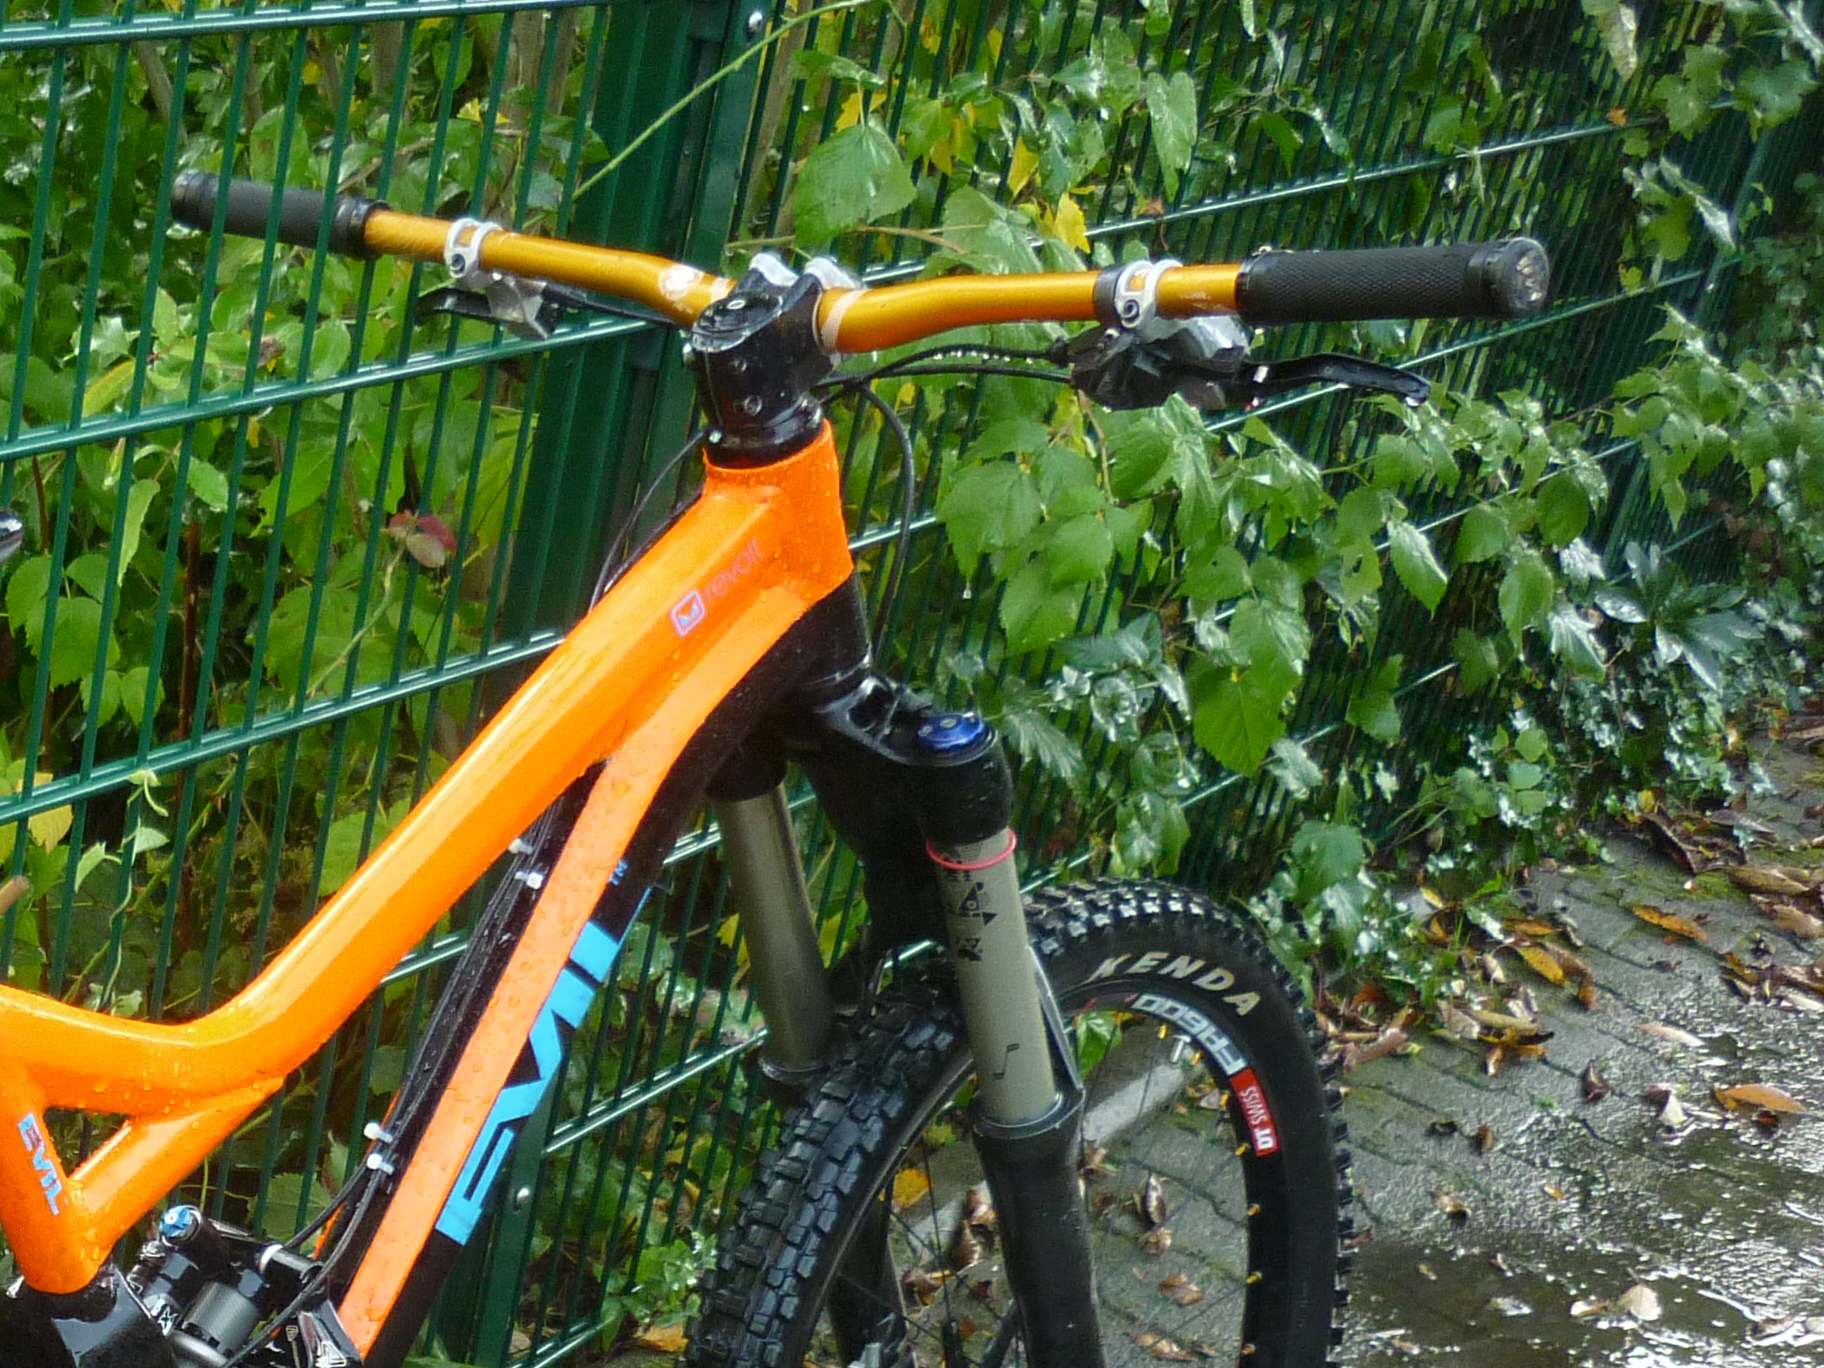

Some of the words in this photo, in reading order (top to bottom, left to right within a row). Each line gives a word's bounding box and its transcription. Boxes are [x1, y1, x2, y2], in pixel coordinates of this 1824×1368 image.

[703, 539, 766, 604] revolt
[1084, 951, 1262, 1017] KENDA
[435, 885, 653, 1246] EVIL
[1240, 1085, 1268, 1126] SWISS
[17, 1112, 63, 1218] EVIL
[1252, 1126, 1275, 1151] DT
